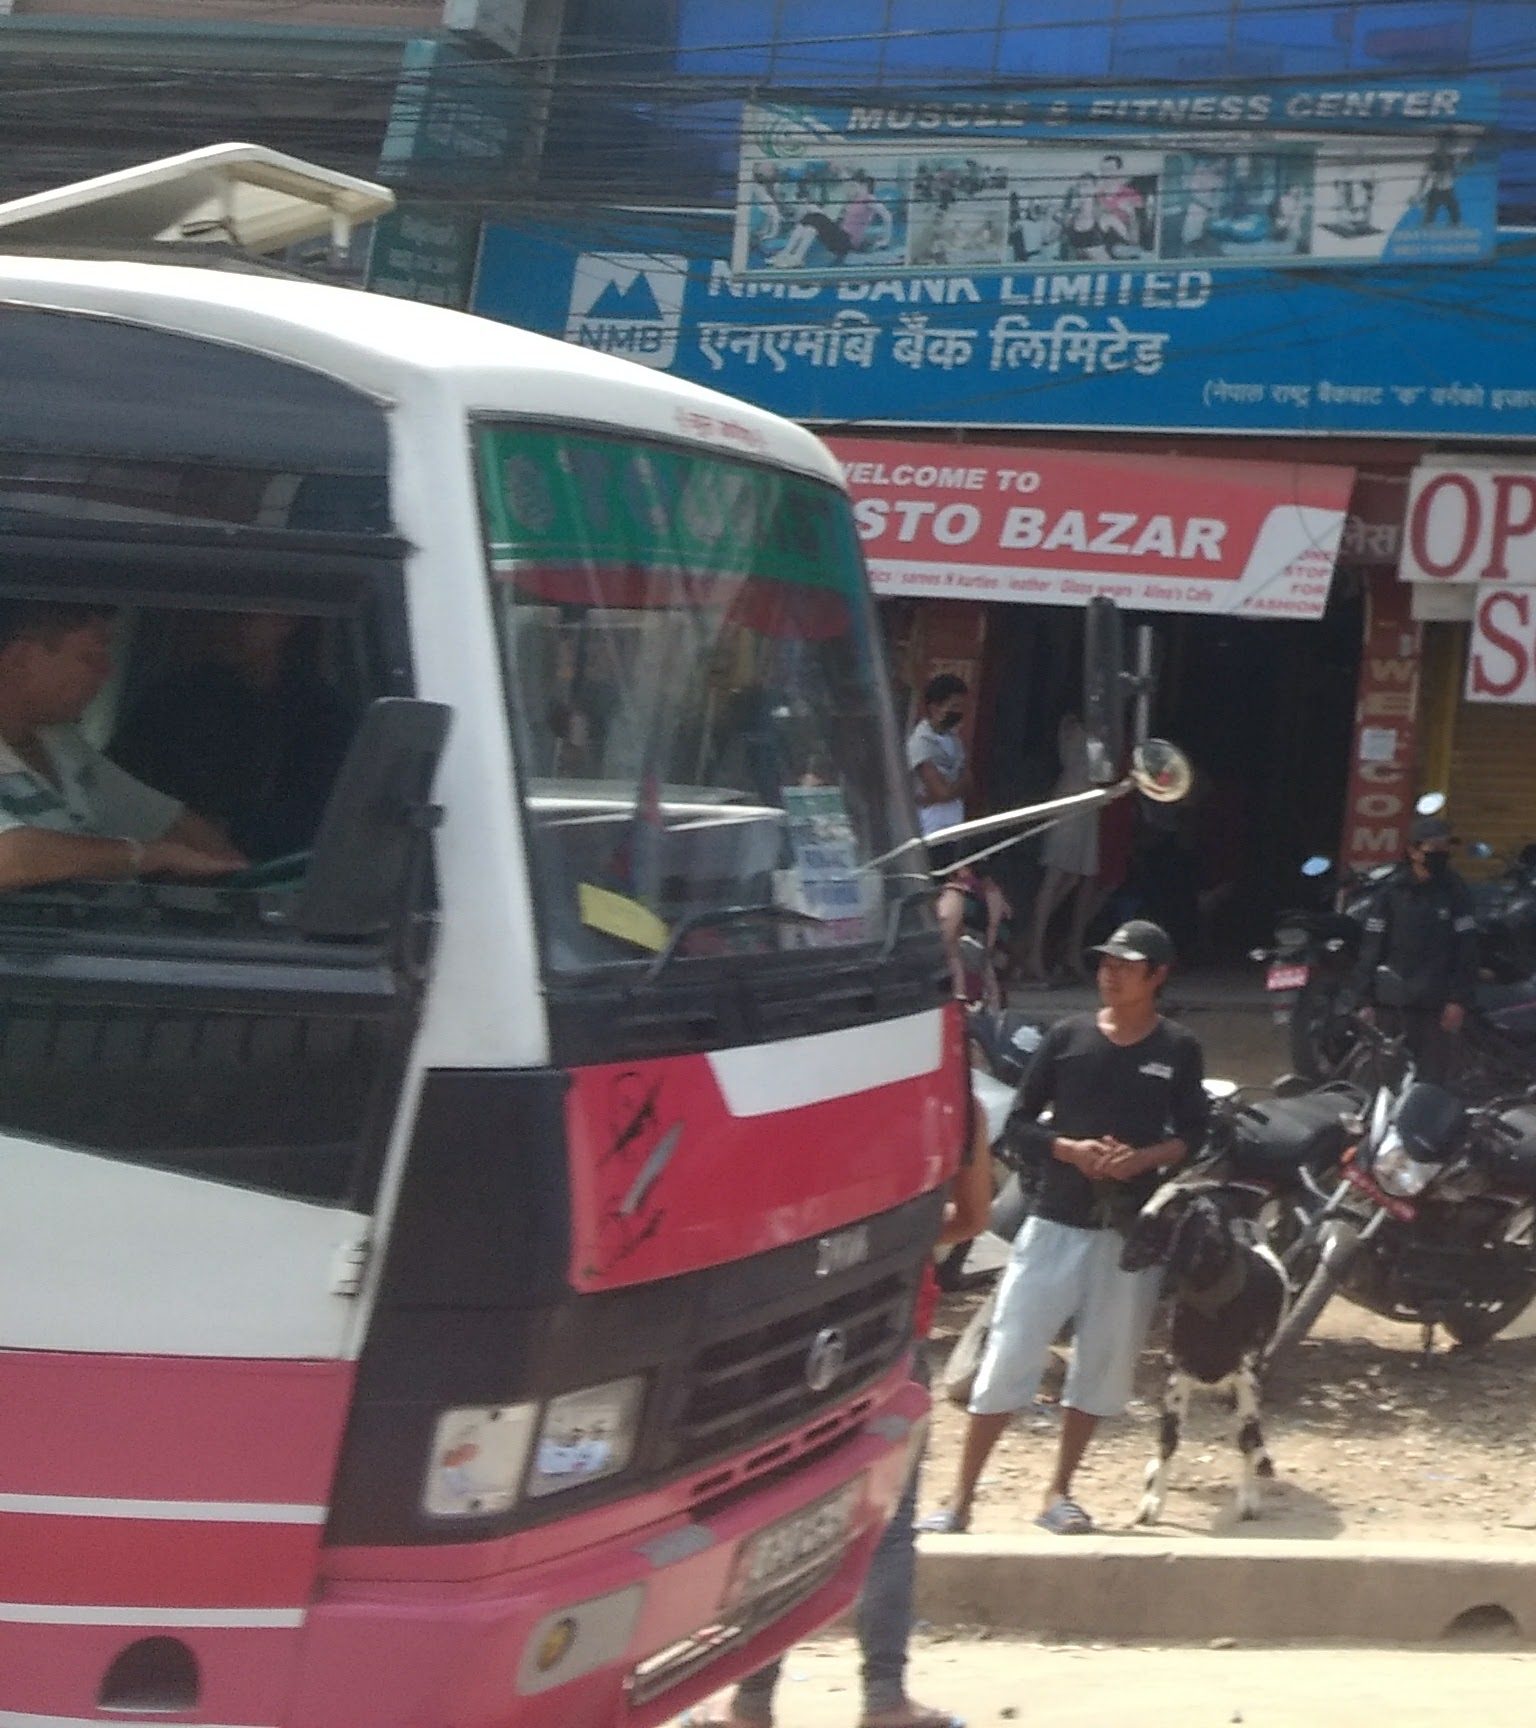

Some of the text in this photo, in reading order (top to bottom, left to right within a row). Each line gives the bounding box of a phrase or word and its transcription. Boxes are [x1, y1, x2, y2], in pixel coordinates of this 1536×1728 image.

[1286, 89, 1461, 118] CENTER
[1001, 269, 1213, 308] LIMITED
[577, 325, 663, 353] NMB
[990, 314, 1169, 374] लिमिटेड
[997, 469, 1041, 493] TO
[999, 506, 1228, 561] BAZAR
